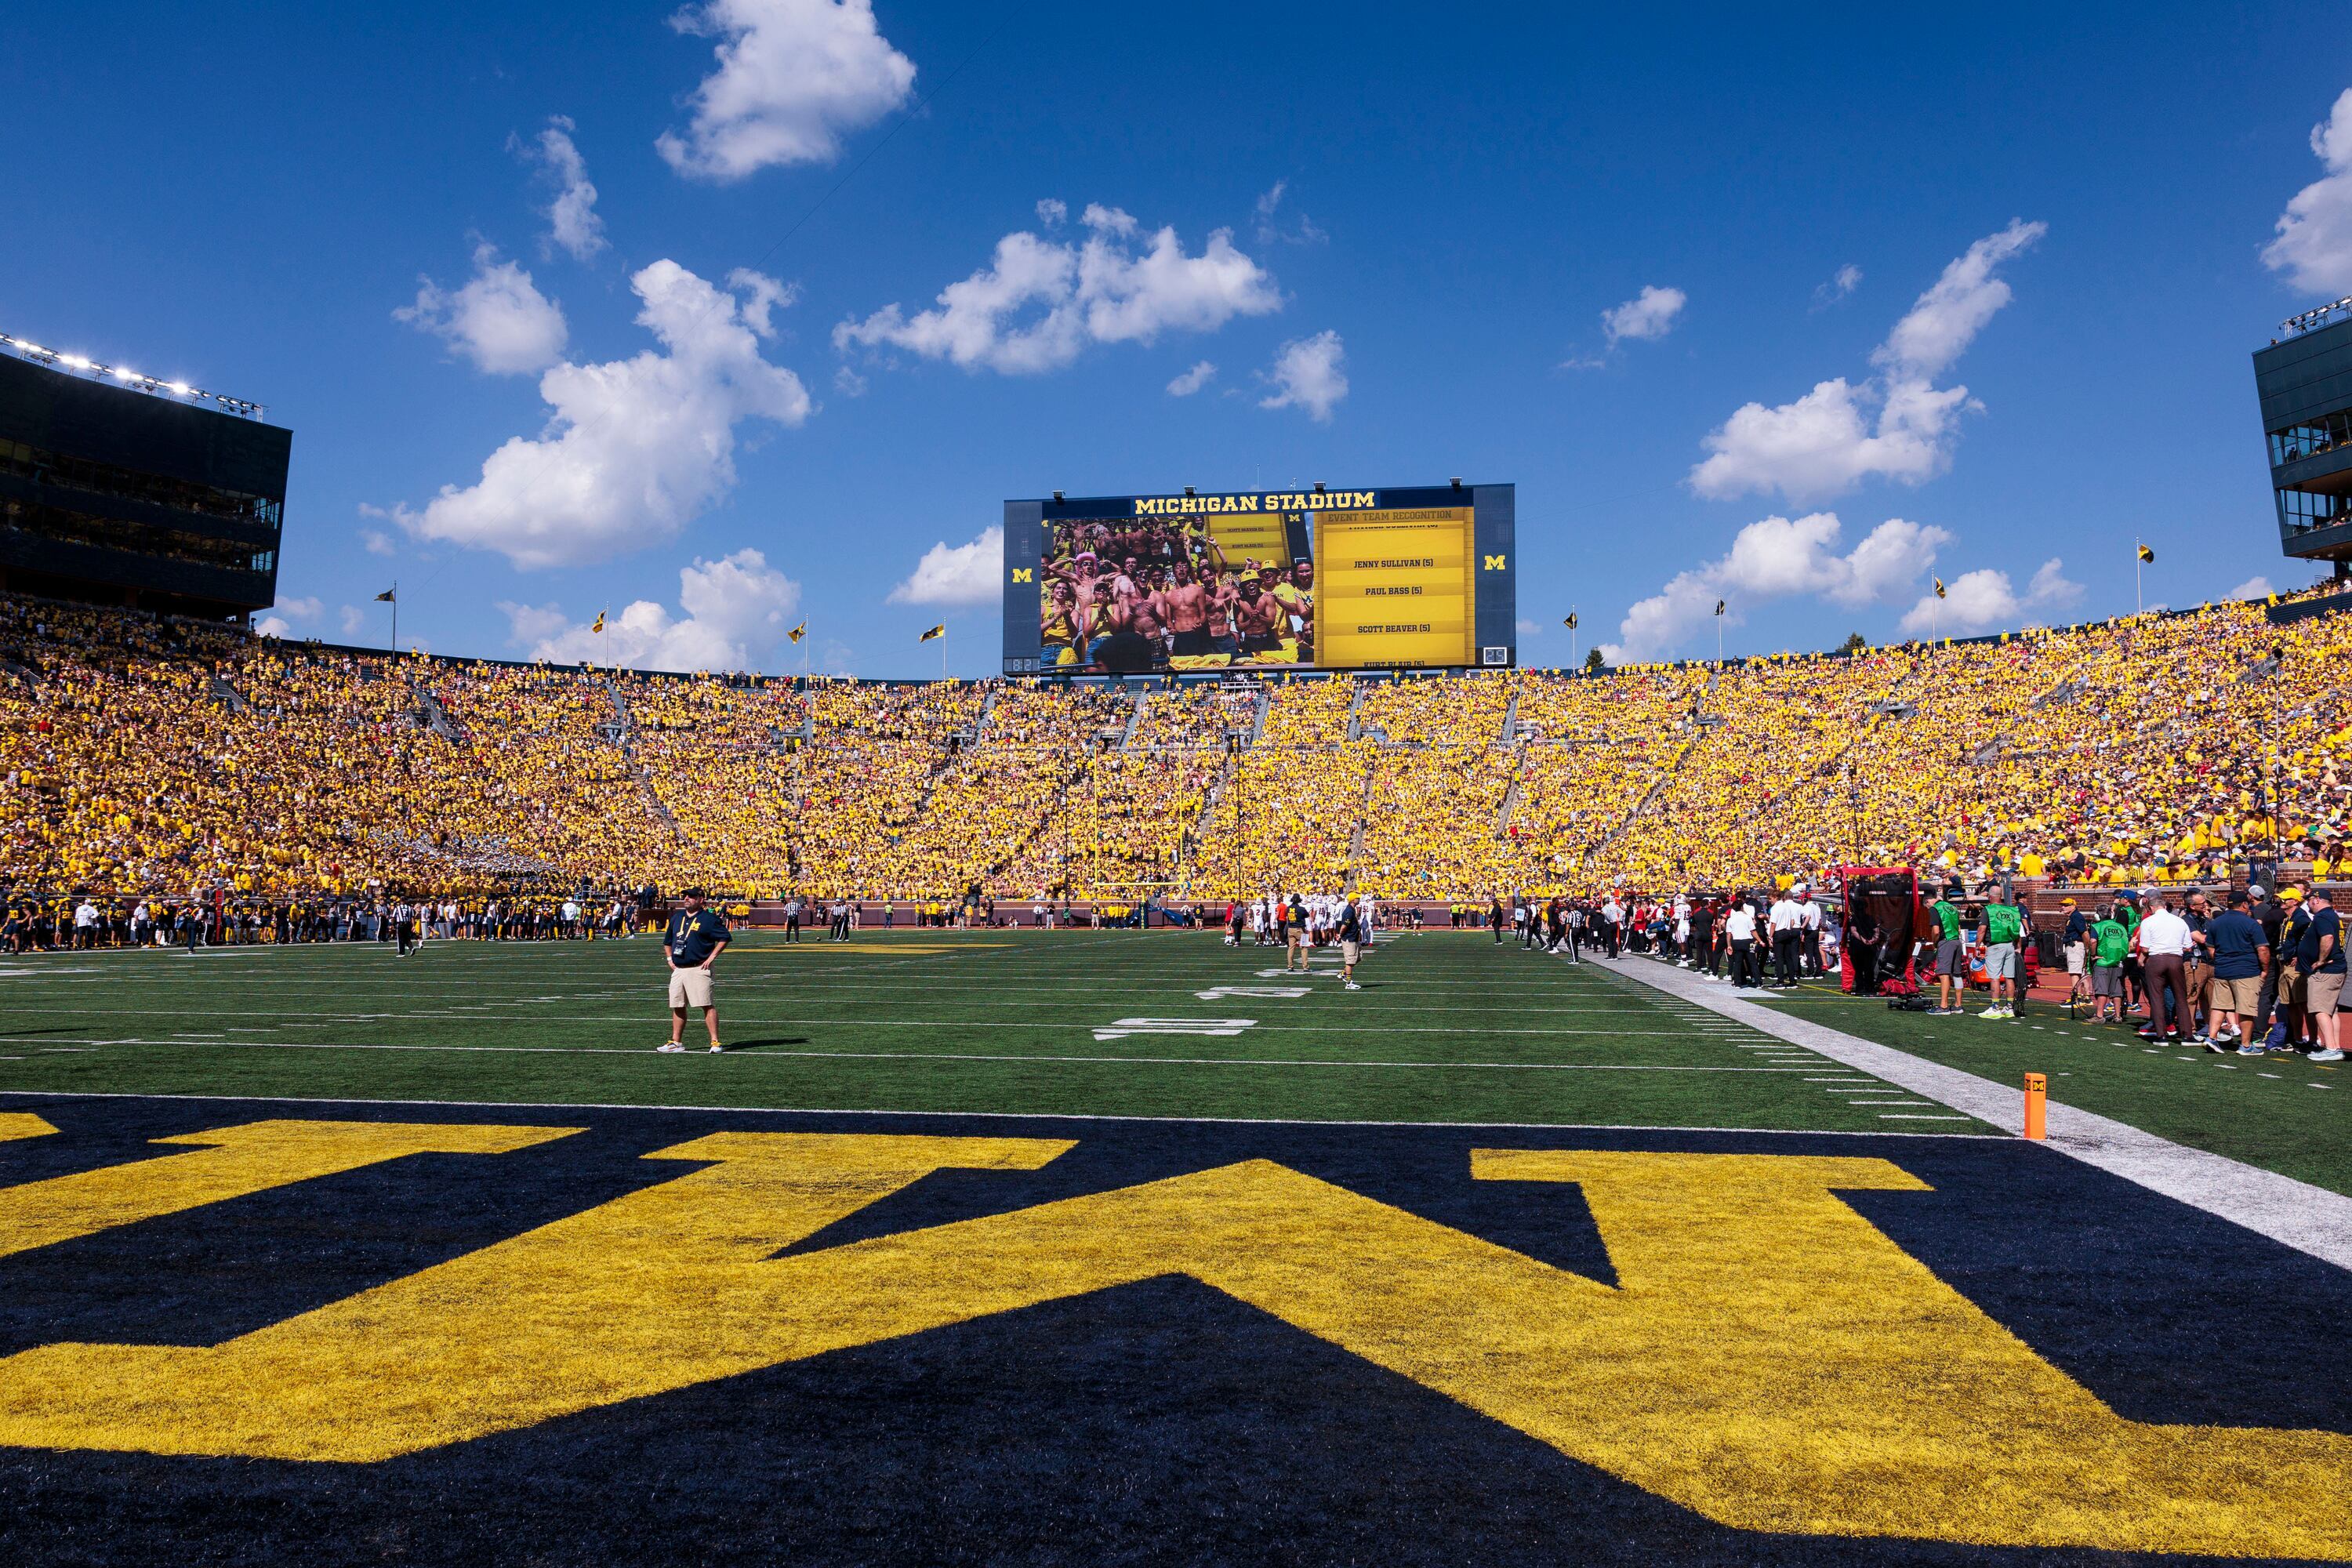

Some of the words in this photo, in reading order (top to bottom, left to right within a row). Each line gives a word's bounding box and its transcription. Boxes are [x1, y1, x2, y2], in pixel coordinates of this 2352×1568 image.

[1135, 495, 1258, 514] MICHIGAN
[1265, 492, 1375, 510] STADIUM
[1328, 514, 1359, 522] EVENT
[1363, 512, 1389, 521] TEAM
[1393, 510, 1452, 521] RECOGNITION
[1354, 560, 1379, 568] JENNY
[1381, 559, 1421, 568] SULLIVAN
[1423, 558, 1433, 567] (5)
[1484, 555, 1505, 570] M
[1012, 568, 1033, 583] M
[1420, 624, 1430, 633] (5)
[1486, 650, 1504, 662] 25
[2033, 1080, 2045, 1091] M
